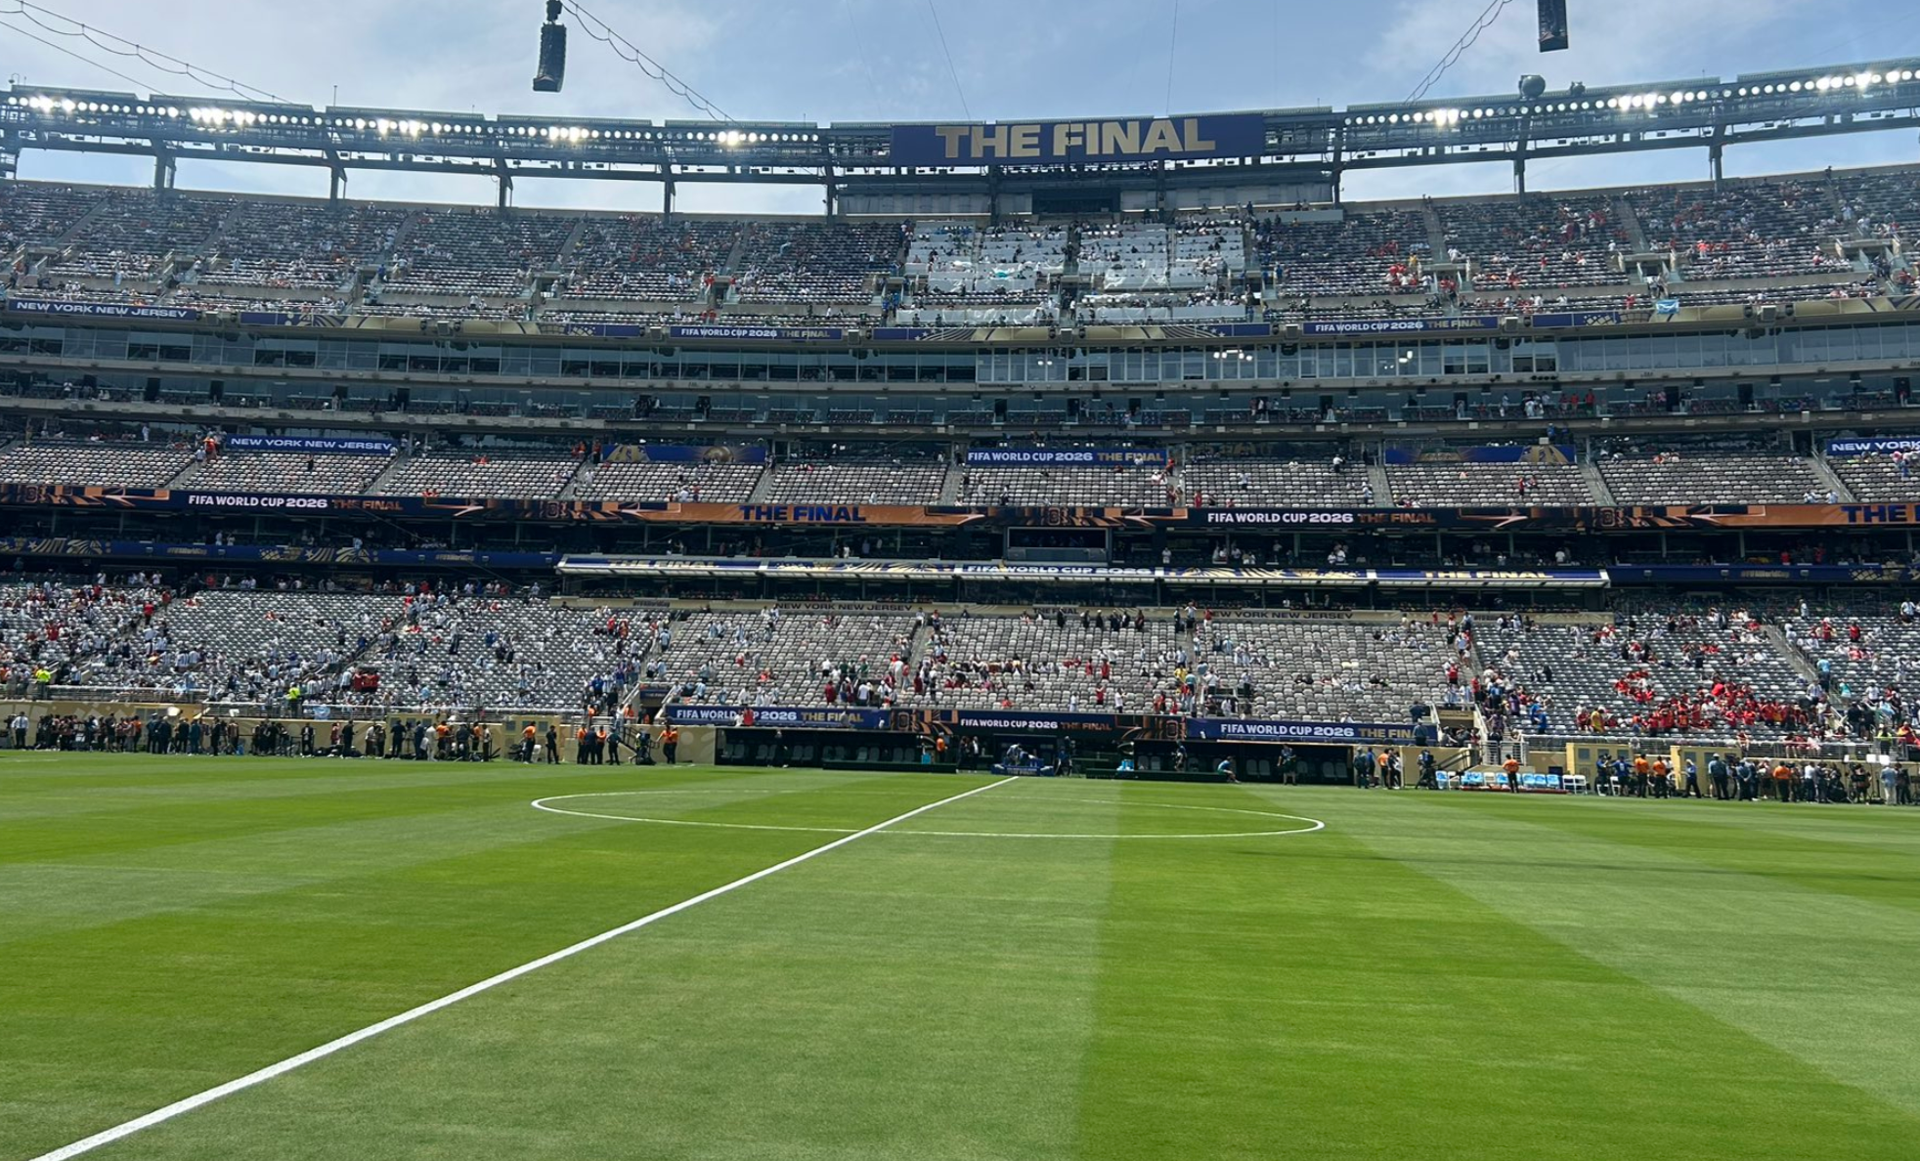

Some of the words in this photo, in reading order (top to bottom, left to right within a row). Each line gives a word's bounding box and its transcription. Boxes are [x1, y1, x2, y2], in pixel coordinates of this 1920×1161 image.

[935, 125, 1041, 159] THE
[1053, 119, 1216, 156] FINAL
[16, 301, 50, 311] NEW
[54, 303, 92, 313] YORK
[96, 305, 129, 315] NEW
[131, 307, 188, 318] JERSEY
[1315, 324, 1335, 332] FIFA
[1336, 322, 1370, 331] WORLD
[1371, 322, 1389, 331] CUP
[1391, 321, 1424, 330] 2026
[1427, 320, 1449, 329] THE
[1451, 320, 1484, 328] FINAL
[681, 328, 699, 336] FIFA
[700, 328, 730, 337] WORLD
[731, 329, 748, 337] CUP
[749, 329, 778, 338] 2026
[780, 330, 799, 338] THE
[801, 330, 830, 338] FINAL
[230, 437, 262, 446] NEW
[265, 438, 302, 447] YORK
[305, 440, 336, 449] NEW
[338, 441, 392, 450] JERSEY
[1831, 442, 1871, 452] NEW
[1874, 440, 1920, 450] YORK
[967, 451, 991, 462] FIFA
[993, 451, 1030, 462] WORLD
[1032, 451, 1054, 462] CUP
[1055, 451, 1094, 462] 2026
[1097, 452, 1123, 462] THE
[1125, 452, 1164, 462] FINAL
[188, 495, 214, 505] FIFA
[215, 495, 259, 506] WORLD
[261, 497, 285, 507] CUP
[286, 498, 328, 508] 2026
[362, 500, 403, 510] FINAL
[739, 505, 787, 521] THE
[793, 506, 866, 522] FINAL
[1207, 513, 1234, 523] FIFA
[1235, 513, 1280, 523] WORLD
[1282, 513, 1308, 523] CUP
[1309, 513, 1354, 523] 2026
[1357, 513, 1388, 523] THE
[1391, 513, 1436, 523] FINAL
[1841, 505, 1908, 523] THE
[608, 559, 652, 568] THE
[654, 560, 720, 569] FINAL
[967, 565, 1000, 573] FIFA
[1003, 566, 1059, 574] WORLD
[1061, 566, 1093, 574] CUP
[1423, 571, 1472, 579] THE
[1476, 571, 1554, 579] FINAL
[776, 602, 801, 610] NEW
[804, 603, 835, 611] YORK
[838, 603, 866, 611] NEW
[866, 604, 913, 612] JERSEY
[1234, 611, 1269, 619] YORK
[1272, 611, 1301, 619] NEW
[1303, 612, 1354, 620] JERSEY
[676, 709, 699, 719] FIFA
[699, 710, 738, 720] WORLD
[760, 711, 798, 720] 2026
[800, 712, 826, 722] THE
[960, 718, 978, 727] FIFA
[979, 719, 1009, 728] WORLD
[1011, 719, 1028, 729] CUP
[1028, 720, 1058, 729] 2026
[1082, 722, 1113, 731] FINAL
[1220, 723, 1245, 734] FIFA
[1245, 724, 1287, 735] WORLD
[1289, 725, 1313, 736] CUP
[1313, 727, 1355, 737] 2026
[1358, 728, 1386, 738] THE
